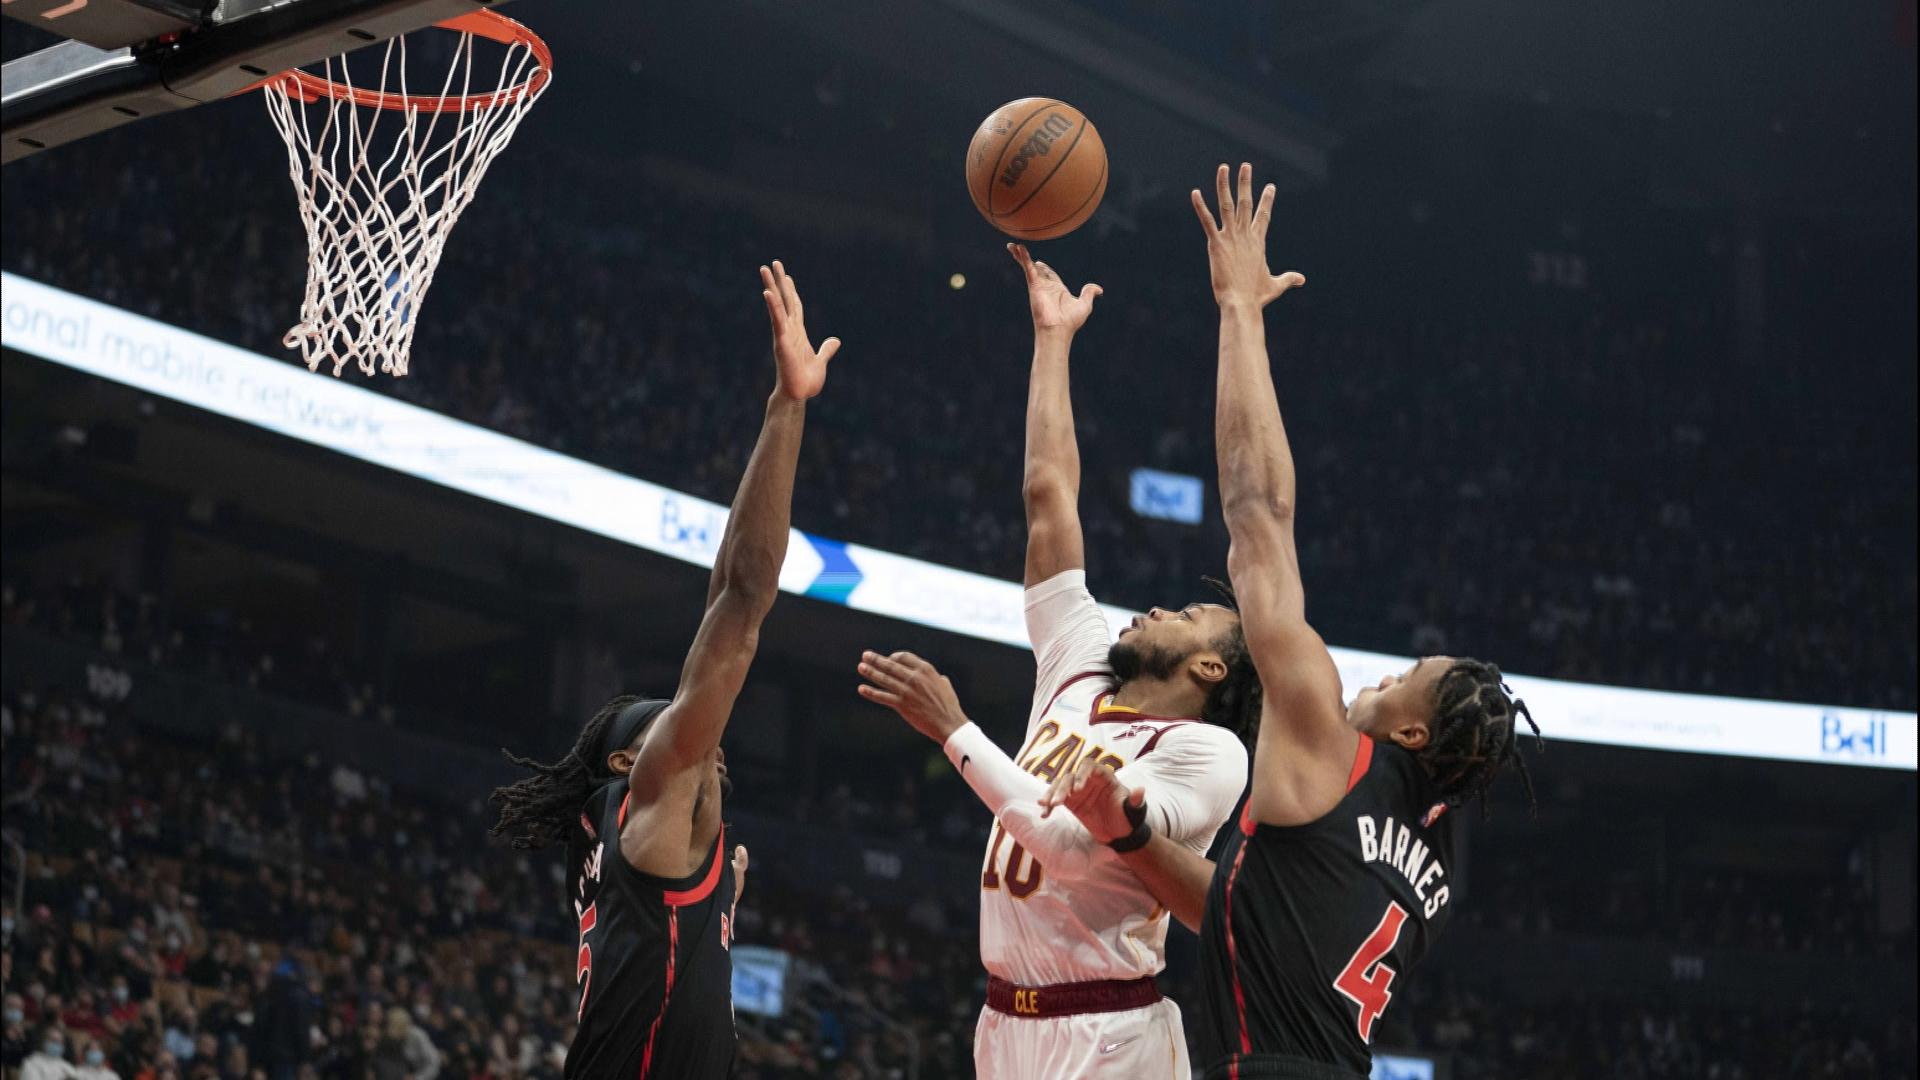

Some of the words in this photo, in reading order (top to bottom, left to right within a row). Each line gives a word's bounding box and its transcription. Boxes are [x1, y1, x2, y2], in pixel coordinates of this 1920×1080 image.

[1002, 112, 1073, 188] Wilson
[100, 330, 224, 390] mobile
[1821, 713, 1886, 756] Bell
[1357, 814, 1450, 920] BARNES
[1014, 990, 1039, 1014] CLE
[1333, 900, 1410, 1045] 4
